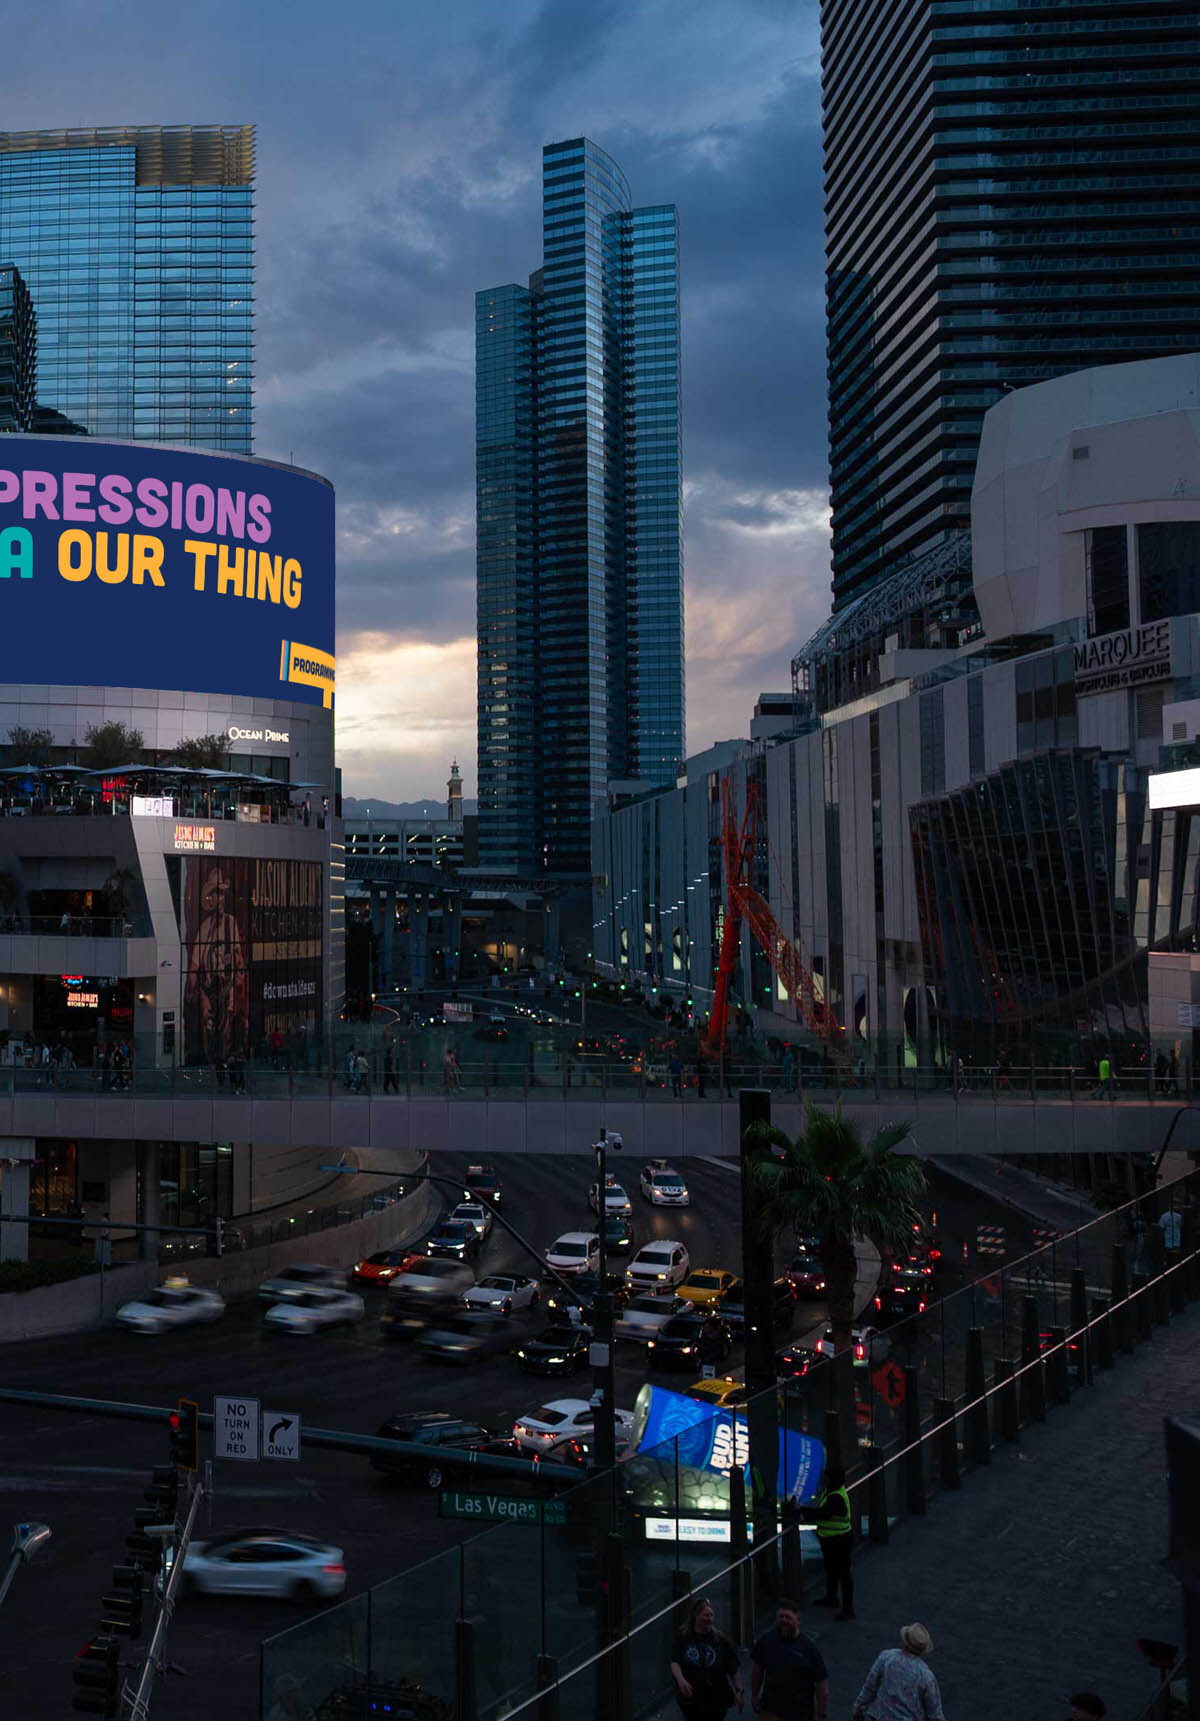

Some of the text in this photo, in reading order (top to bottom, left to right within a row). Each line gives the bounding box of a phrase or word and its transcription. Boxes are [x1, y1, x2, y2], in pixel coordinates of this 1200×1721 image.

[57, 528, 165, 587] OUR
[183, 539, 303, 609] THING
[1074, 622, 1169, 672] MARQUEE
[227, 1404, 246, 1416] NO
[224, 1418, 250, 1429] TURN
[230, 1431, 244, 1441] ON
[226, 1443, 247, 1454] RED
[268, 1445, 294, 1456] ONLY
[710, 1423, 731, 1469] BUD
[455, 1493, 536, 1519] Las Vegas
